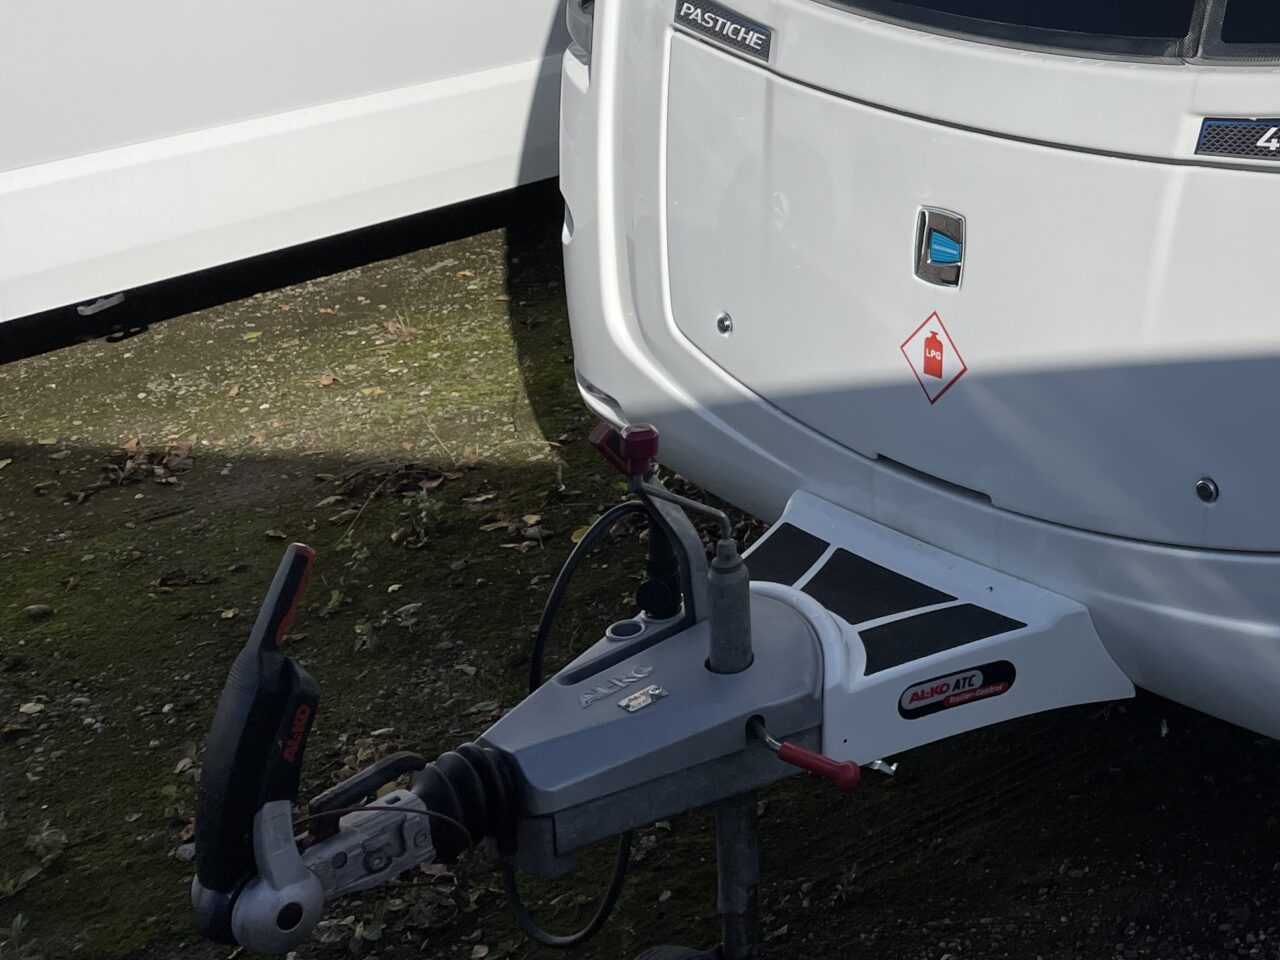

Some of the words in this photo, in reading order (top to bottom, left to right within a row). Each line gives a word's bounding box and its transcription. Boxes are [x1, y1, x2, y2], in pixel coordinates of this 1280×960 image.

[680, 2, 766, 50] PASTICHE
[925, 347, 942, 361] LPG
[908, 683, 950, 704] AL-KO
[952, 674, 977, 692] ATC
[283, 704, 311, 763] AL-KO
